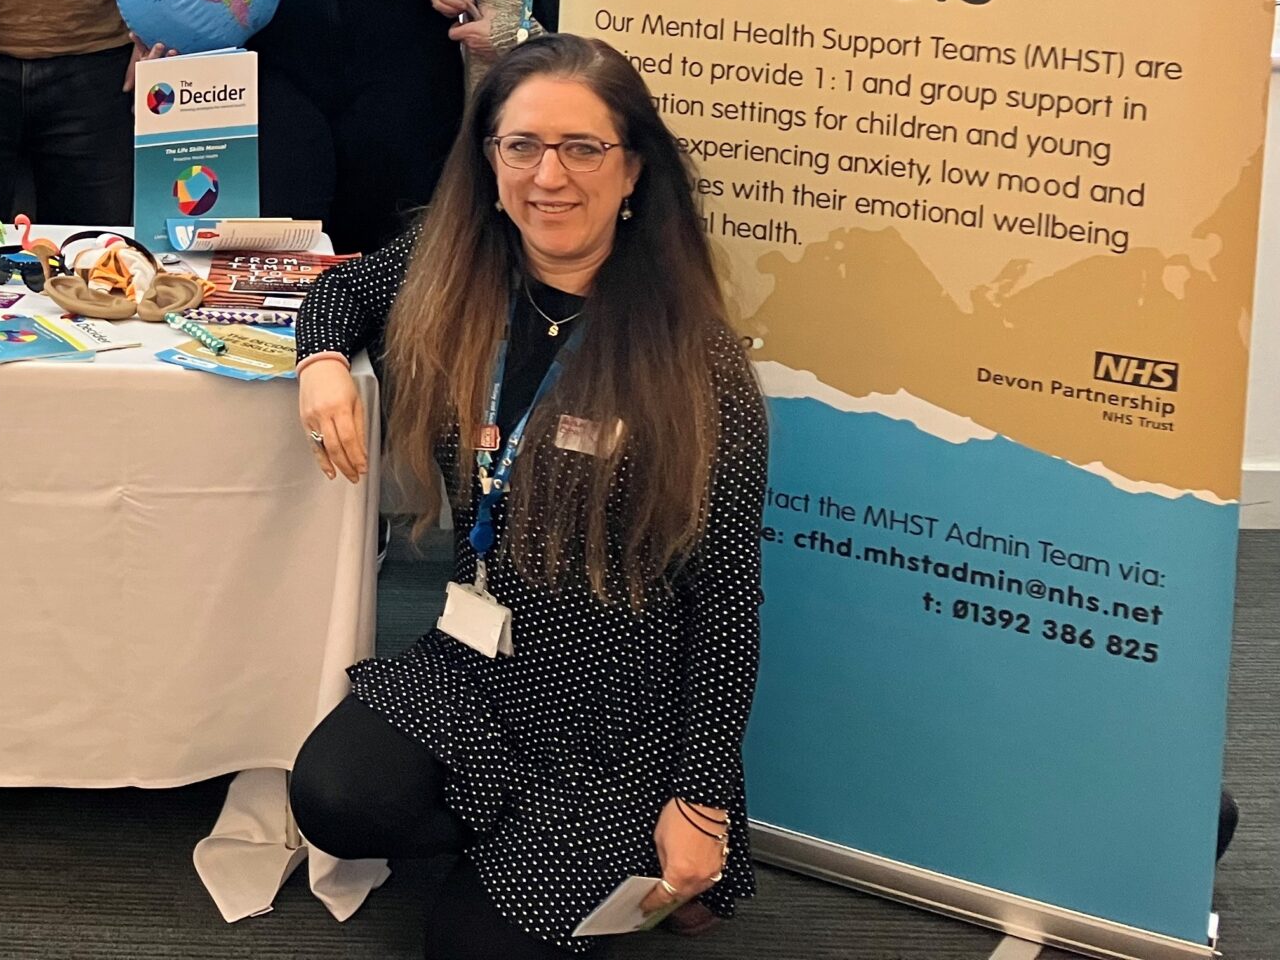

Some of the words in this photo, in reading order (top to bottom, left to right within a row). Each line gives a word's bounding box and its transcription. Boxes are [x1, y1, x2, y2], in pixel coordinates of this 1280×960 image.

[595, 10, 634, 32] Our
[641, 14, 725, 41] Mental
[733, 20, 815, 48] Health
[822, 28, 922, 59] Support
[930, 36, 1017, 65] Teams
[1024, 43, 1125, 78] (MHST)
[1135, 59, 1183, 80] are
[179, 85, 246, 105] Decider
[180, 80, 193, 88] The
[681, 56, 704, 77] to
[710, 62, 804, 87] provide
[862, 74, 912, 97] and
[920, 80, 998, 110] group
[1005, 89, 1113, 118] support
[1123, 96, 1148, 121] in
[189, 145, 205, 153] Skills
[206, 143, 227, 151] Manual
[711, 100, 807, 131] settings
[815, 106, 848, 131] for
[856, 111, 958, 143] children
[966, 125, 1018, 149] and
[1026, 134, 1111, 166] young
[676, 137, 830, 174] experiencing
[837, 154, 932, 186] anxiety,
[941, 159, 990, 187] low
[997, 172, 1081, 199] mood
[1090, 183, 1145, 207] and
[722, 213, 803, 245] health.
[732, 180, 785, 204] with
[792, 184, 848, 211] their
[855, 196, 985, 228] emotional
[993, 212, 1130, 254] wellbeing
[228, 262, 312, 272] TIMID
[234, 257, 298, 265] FROM
[77, 322, 111, 343] Decider
[253, 337, 297, 352] DECIDER
[1095, 353, 1177, 390] NHS
[977, 367, 1043, 392] Devon
[1050, 380, 1176, 417] Partnership
[1102, 410, 1133, 425] NHS
[1138, 416, 1175, 431] Trust
[766, 487, 810, 514] tact
[819, 497, 856, 522] the
[863, 505, 940, 540] MHST
[945, 522, 1030, 560] Admin
[1038, 540, 1111, 577] Team
[1119, 562, 1166, 589] via:
[761, 526, 785, 544] e:
[794, 528, 1164, 627] cfhd.mhstadmin@nhs.net
[922, 592, 942, 615] t:
[952, 599, 1031, 635] 01392
[1042, 618, 1095, 650] 386
[1106, 635, 1159, 664] 825
